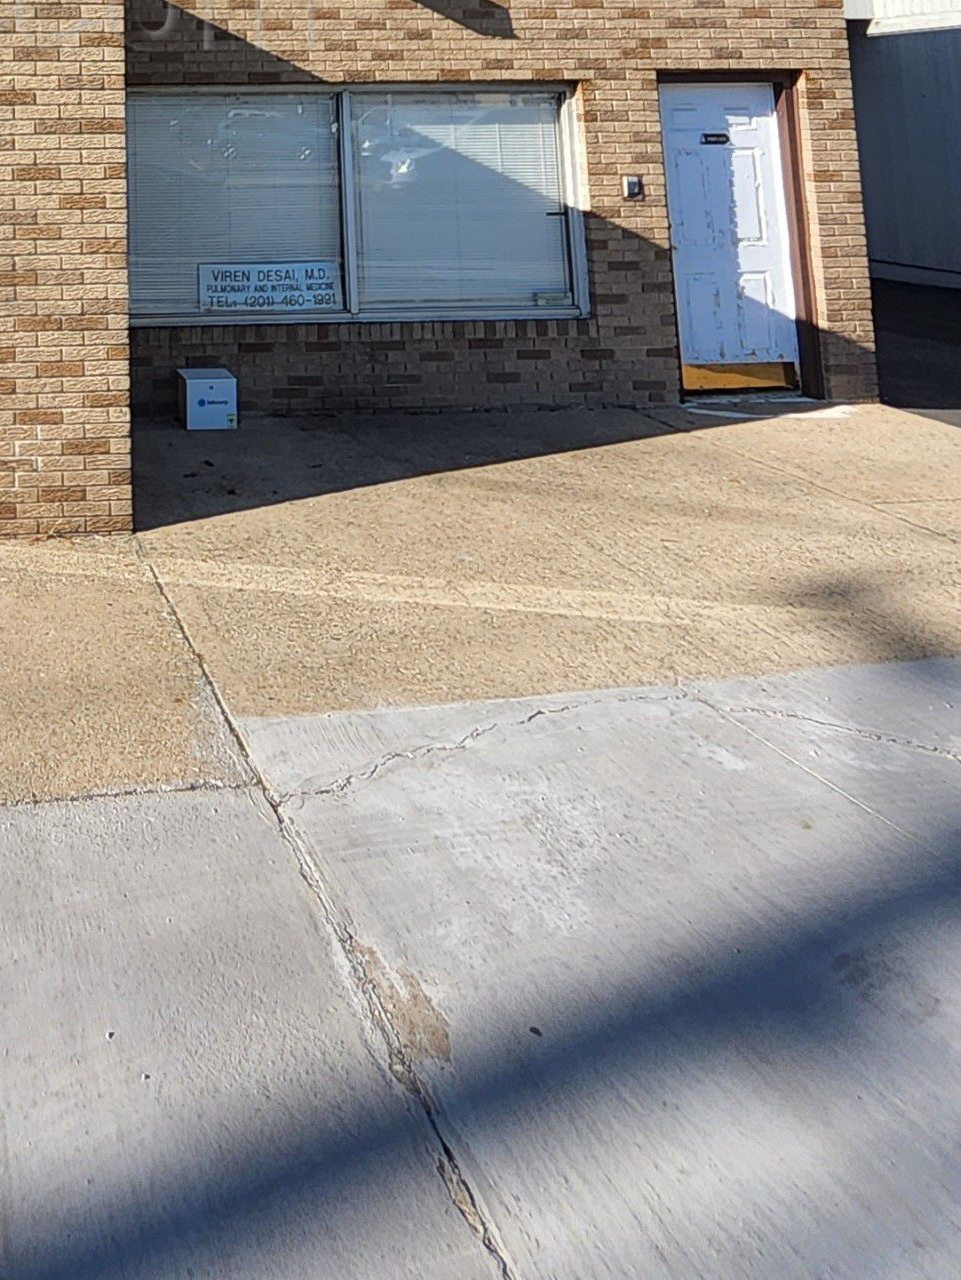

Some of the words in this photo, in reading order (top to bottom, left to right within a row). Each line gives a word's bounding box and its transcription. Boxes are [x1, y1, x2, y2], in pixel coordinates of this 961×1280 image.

[211, 269, 251, 283] VIREN
[257, 269, 299, 283] DESAI,
[304, 268, 330, 281] M.D.
[206, 283, 251, 293] PULMONARY
[254, 283, 269, 293] AND
[271, 283, 303, 292] INTERNAL
[306, 282, 335, 291] MEDICINE
[244, 295, 275, 308] (201)
[281, 293, 337, 307] 460-1991
